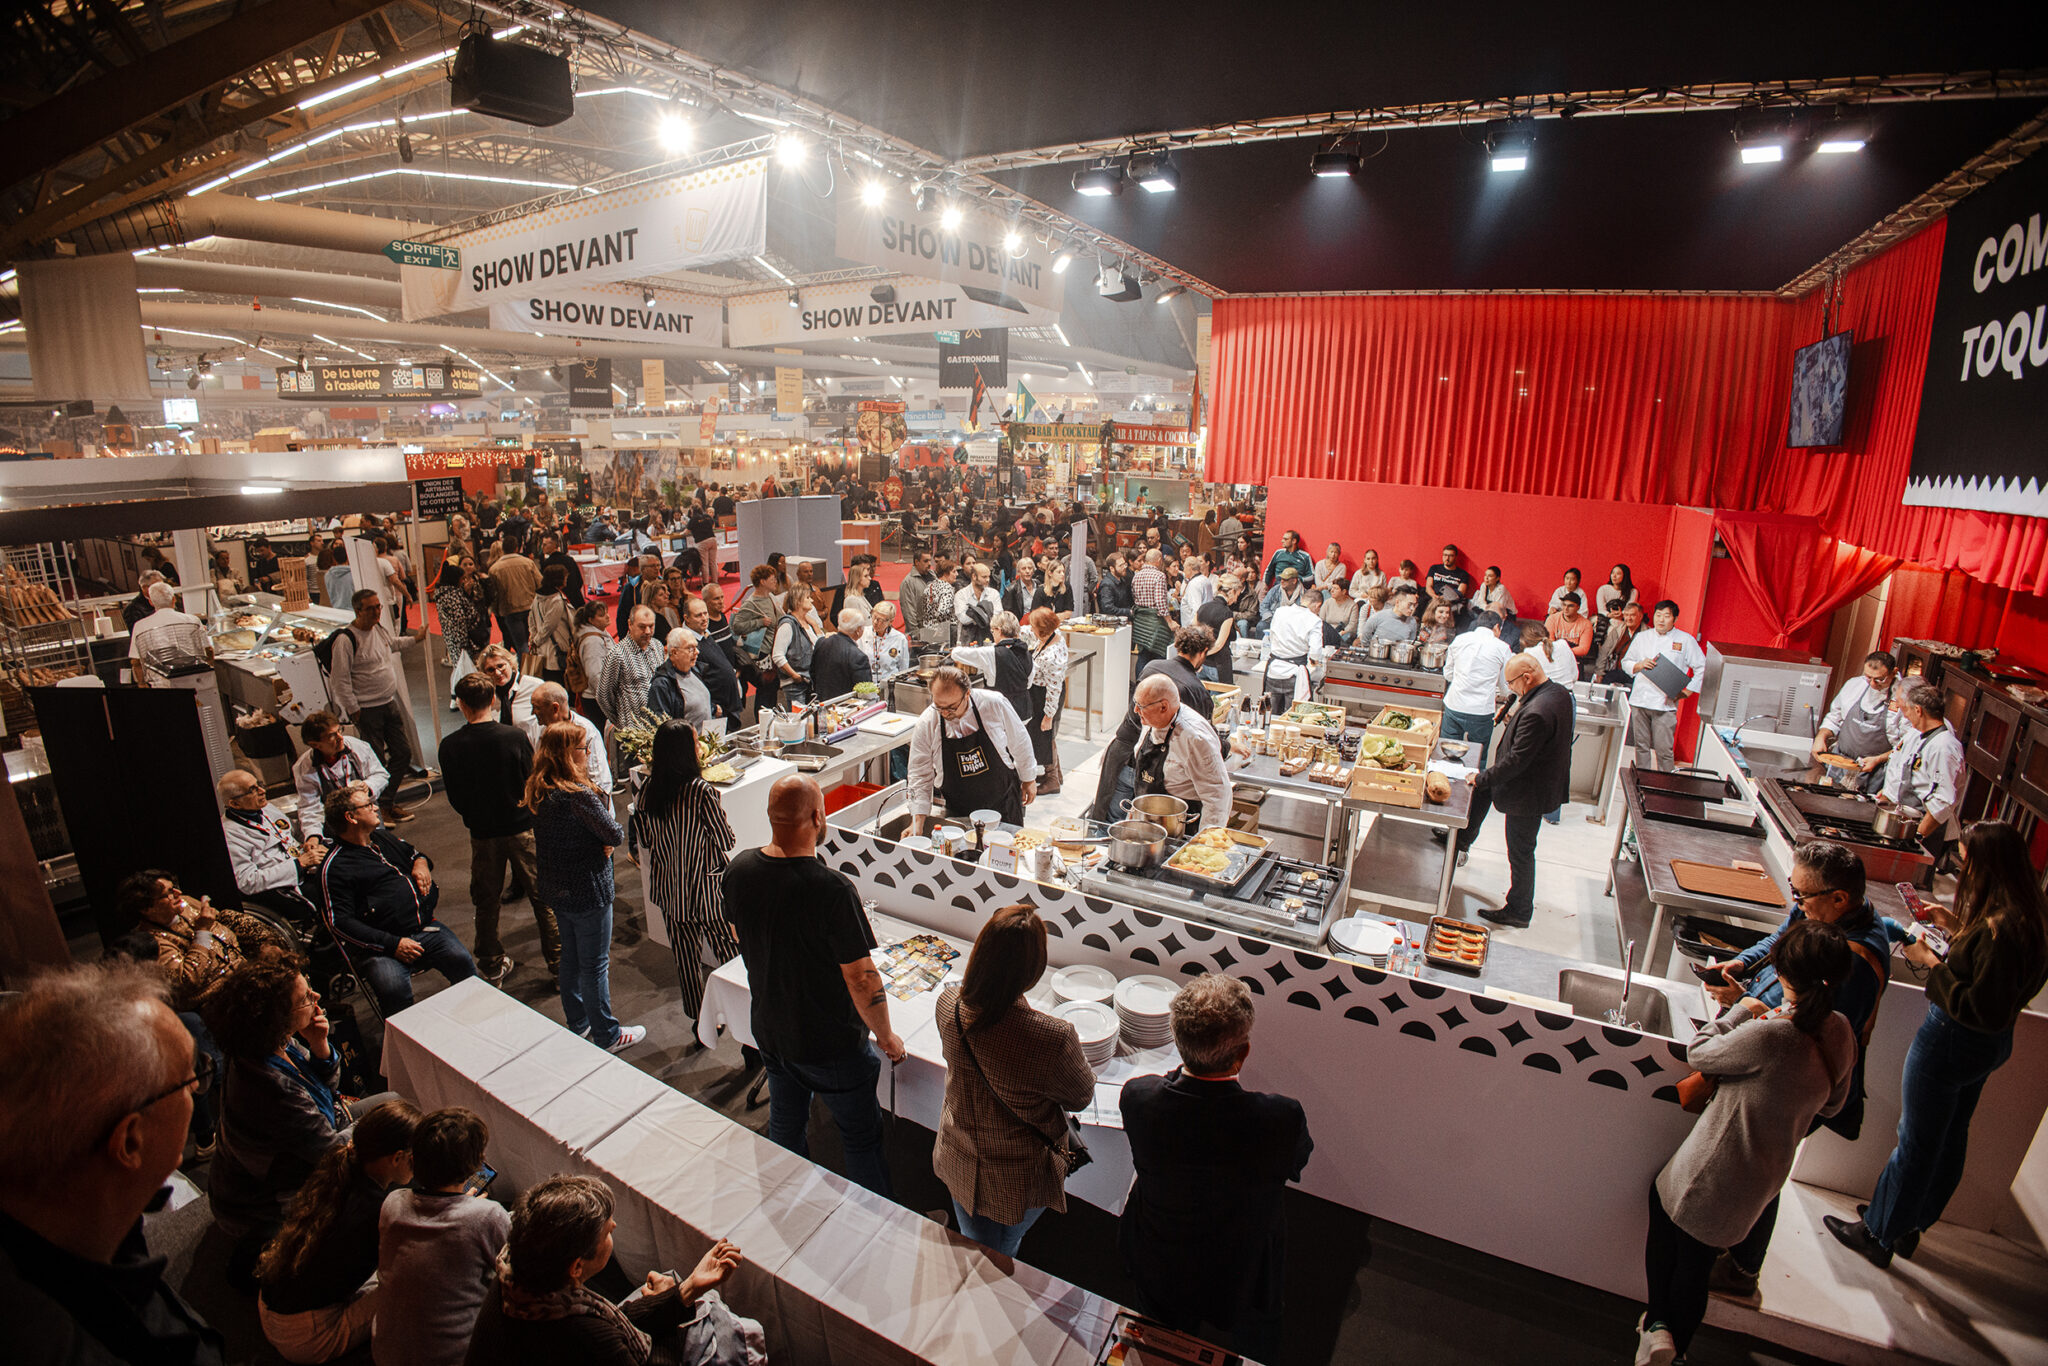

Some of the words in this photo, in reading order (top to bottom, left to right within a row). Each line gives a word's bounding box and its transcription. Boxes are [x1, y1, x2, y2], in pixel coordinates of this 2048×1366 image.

[392, 241, 440, 256] SORTIE
[882, 216, 961, 266] SHOW
[967, 240, 1042, 290] DEVANT
[403, 255, 431, 265] EXIT
[472, 251, 534, 293] SHOW
[540, 228, 638, 278] DEVANT
[530, 298, 604, 325] SHOW
[611, 307, 693, 333] DEVANT
[802, 306, 863, 331] SHOW
[868, 298, 957, 325] DEVANT
[947, 355, 1000, 363] GASTRONOMIE
[322, 368, 337, 379] De
[339, 368, 350, 378] la
[351, 368, 380, 378] terre
[325, 381, 333, 391] à
[334, 379, 380, 391] l'assiette
[1036, 426, 1051, 436] BAR
[1134, 429, 1156, 441] TAPAS
[1157, 431, 1163, 442] &
[420, 490, 459, 499] BOULANGERS
[425, 485, 454, 493] ARTISANS
[962, 762, 985, 773] Dijon
